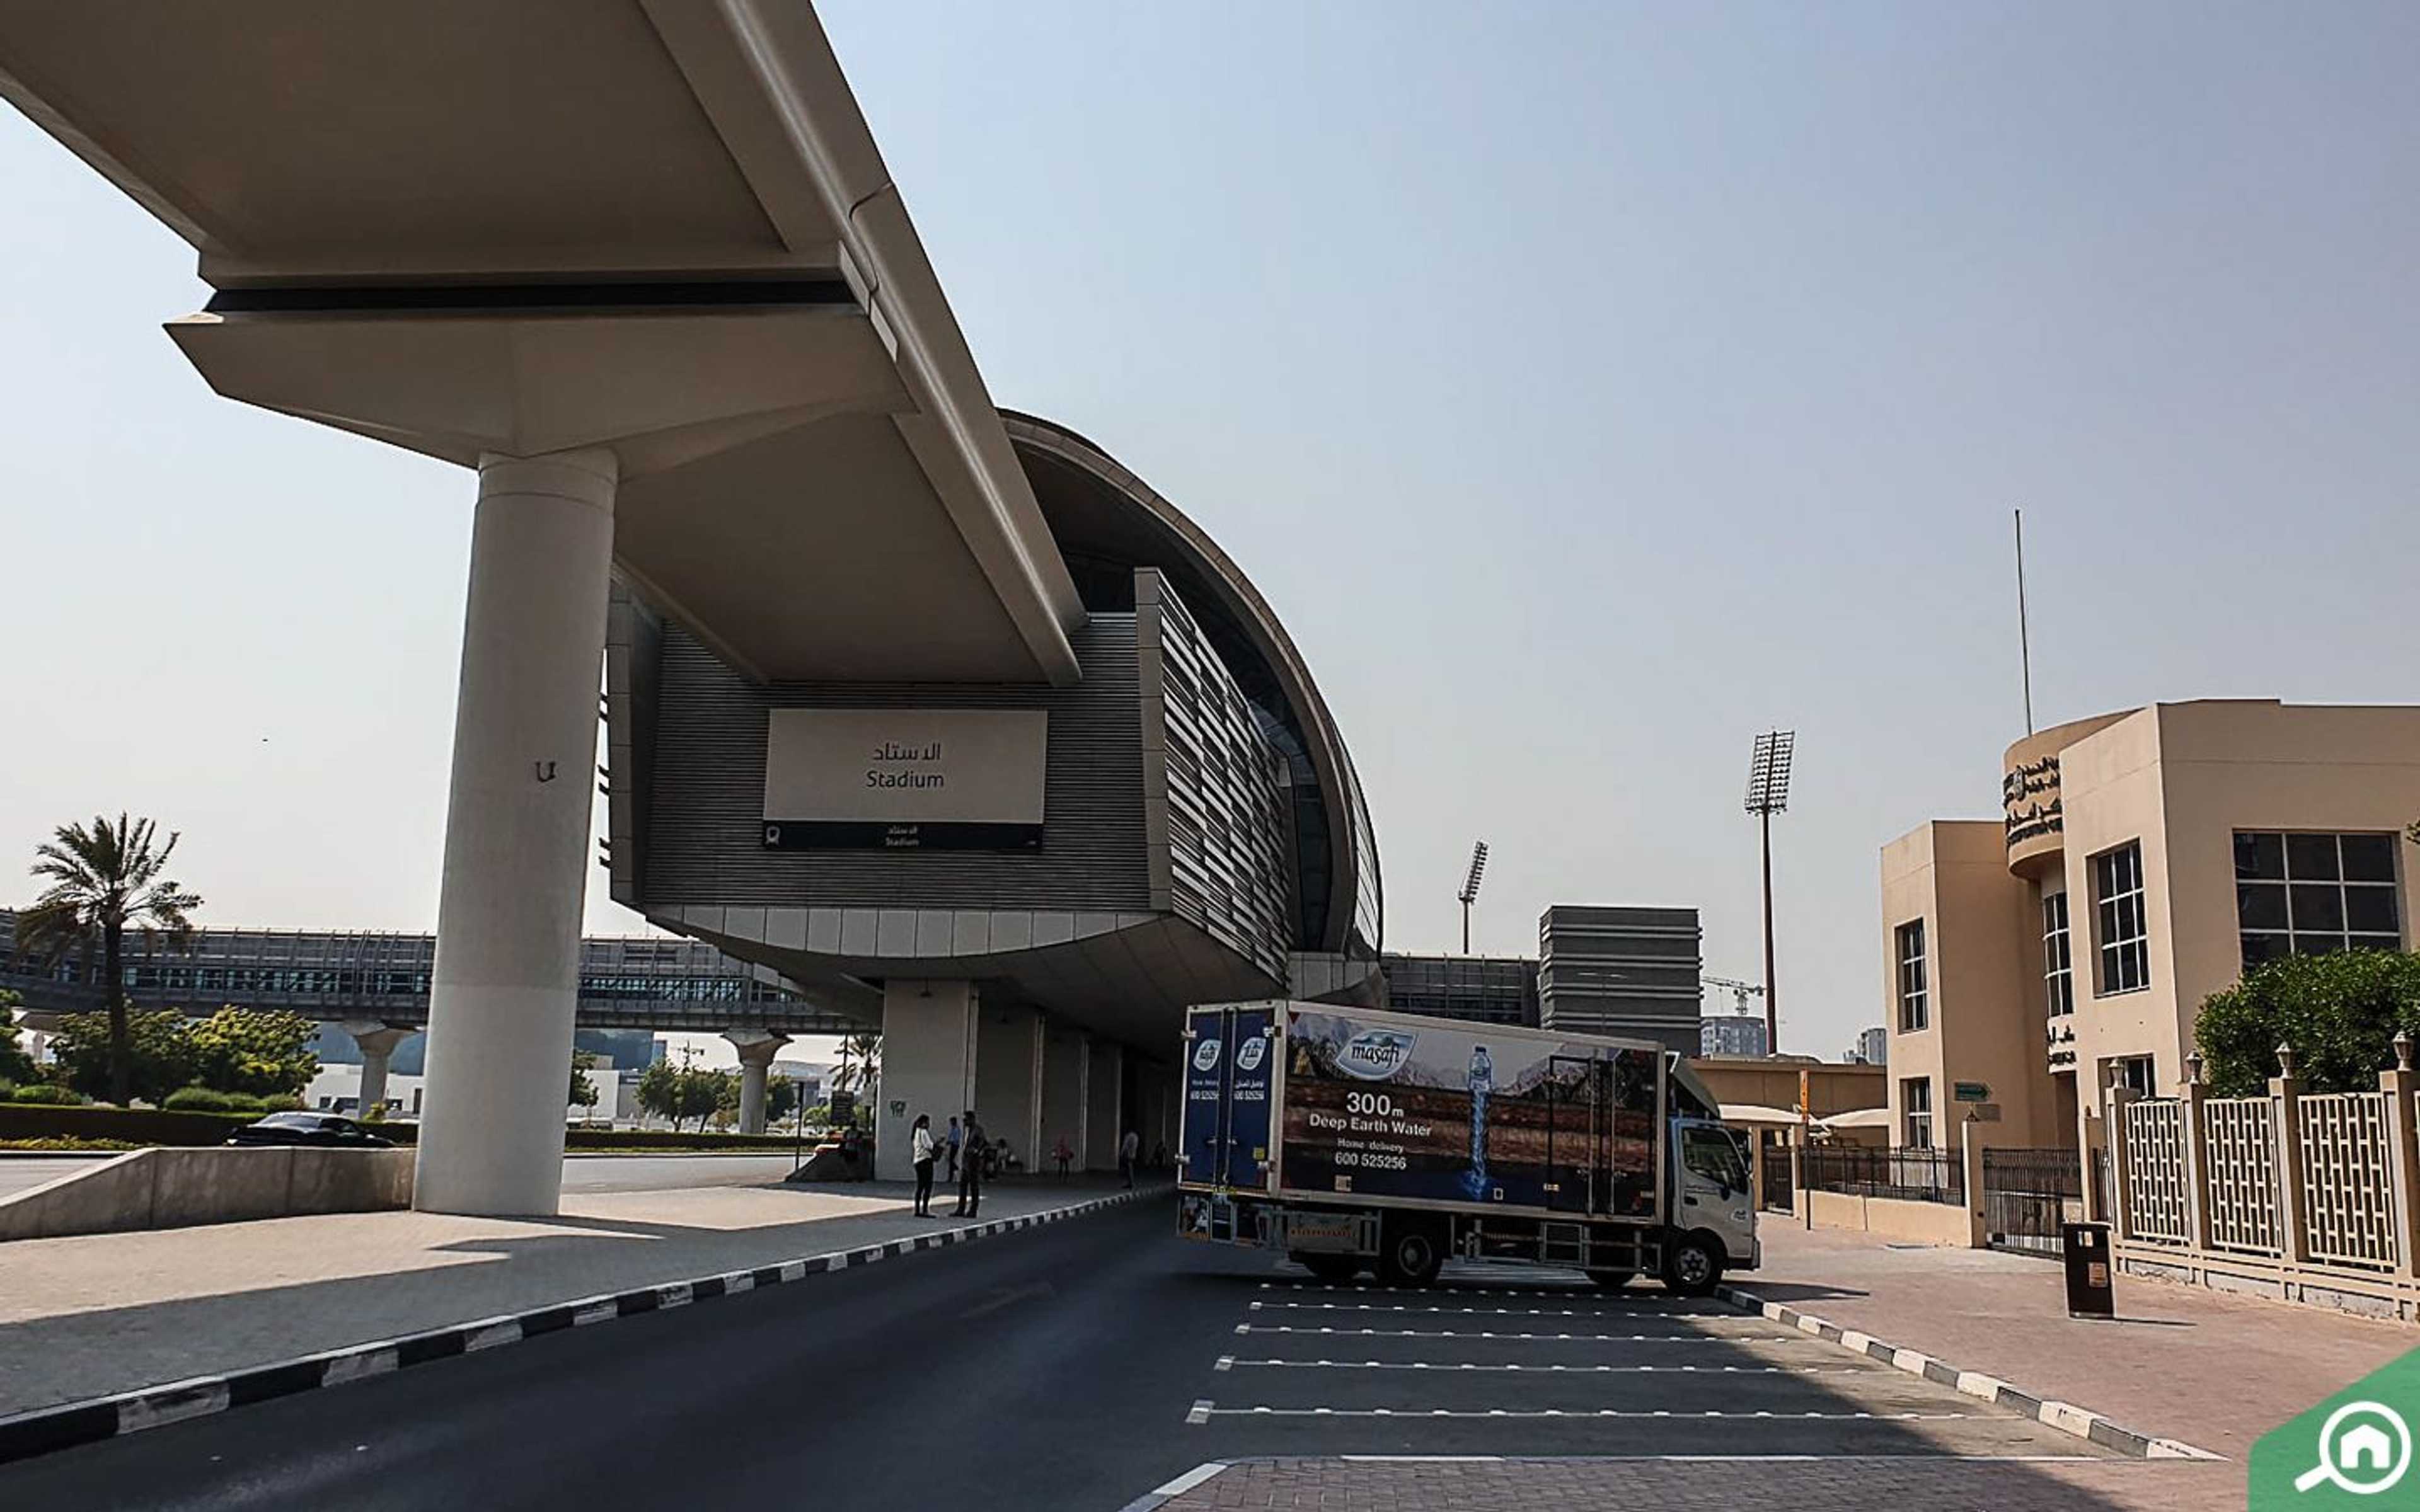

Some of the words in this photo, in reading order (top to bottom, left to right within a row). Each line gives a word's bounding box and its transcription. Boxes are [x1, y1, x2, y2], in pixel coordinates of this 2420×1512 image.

[867, 770, 943, 788] Stadium
[1351, 1041, 1399, 1068] masafi
[1310, 1113, 1347, 1131] Deep
[1351, 1117, 1388, 1133] Earth
[1392, 1121, 1432, 1137] Water
[1337, 1138, 1365, 1148] Home
[1369, 1141, 1405, 1155] delivery
[1335, 1152, 1359, 1166] 600
[1361, 1154, 1407, 1171] 525256
